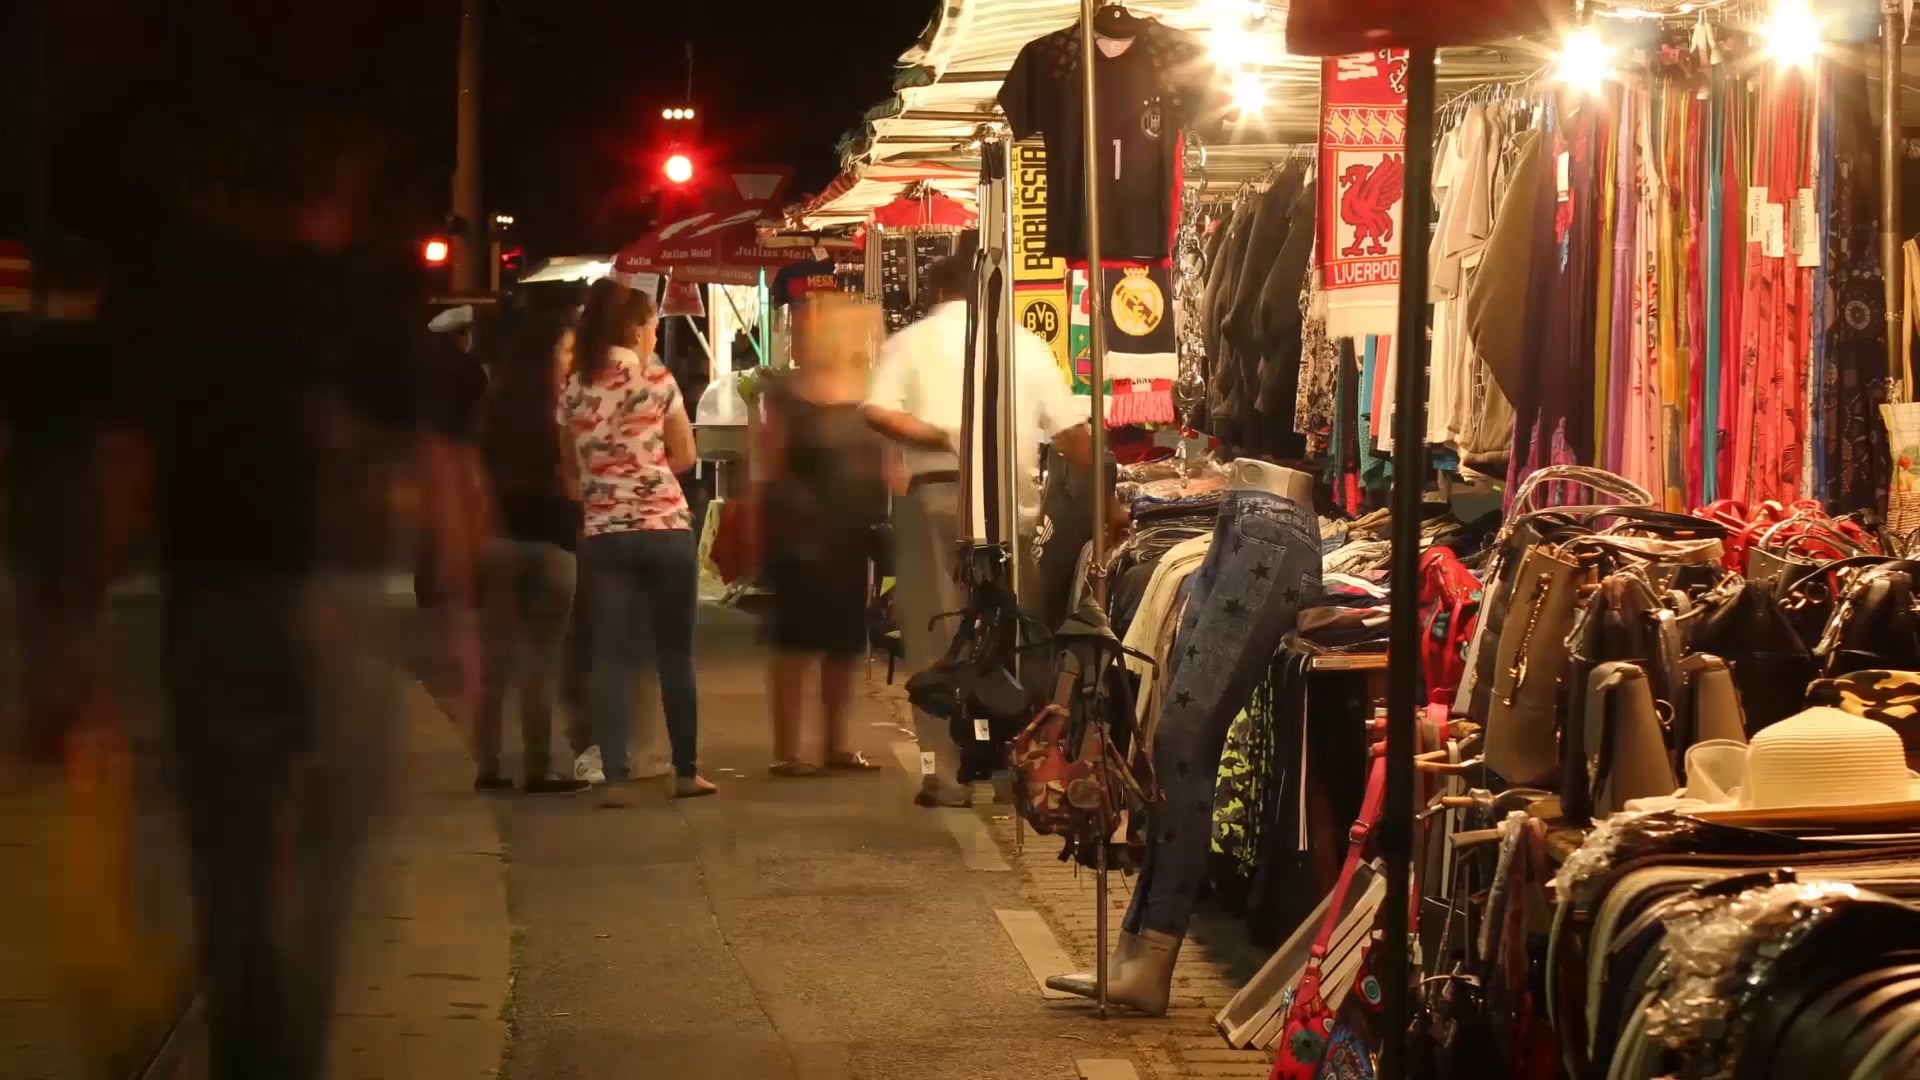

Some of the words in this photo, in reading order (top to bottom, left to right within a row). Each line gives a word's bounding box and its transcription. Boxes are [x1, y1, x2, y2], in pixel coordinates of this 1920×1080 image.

[1112, 138, 1121, 180] 1
[660, 249, 689, 260] Julius
[735, 246, 778, 257] Julius
[783, 248, 815, 260] Mein
[1334, 260, 1400, 285] LIVERPOO
[1026, 303, 1055, 332] BVB
